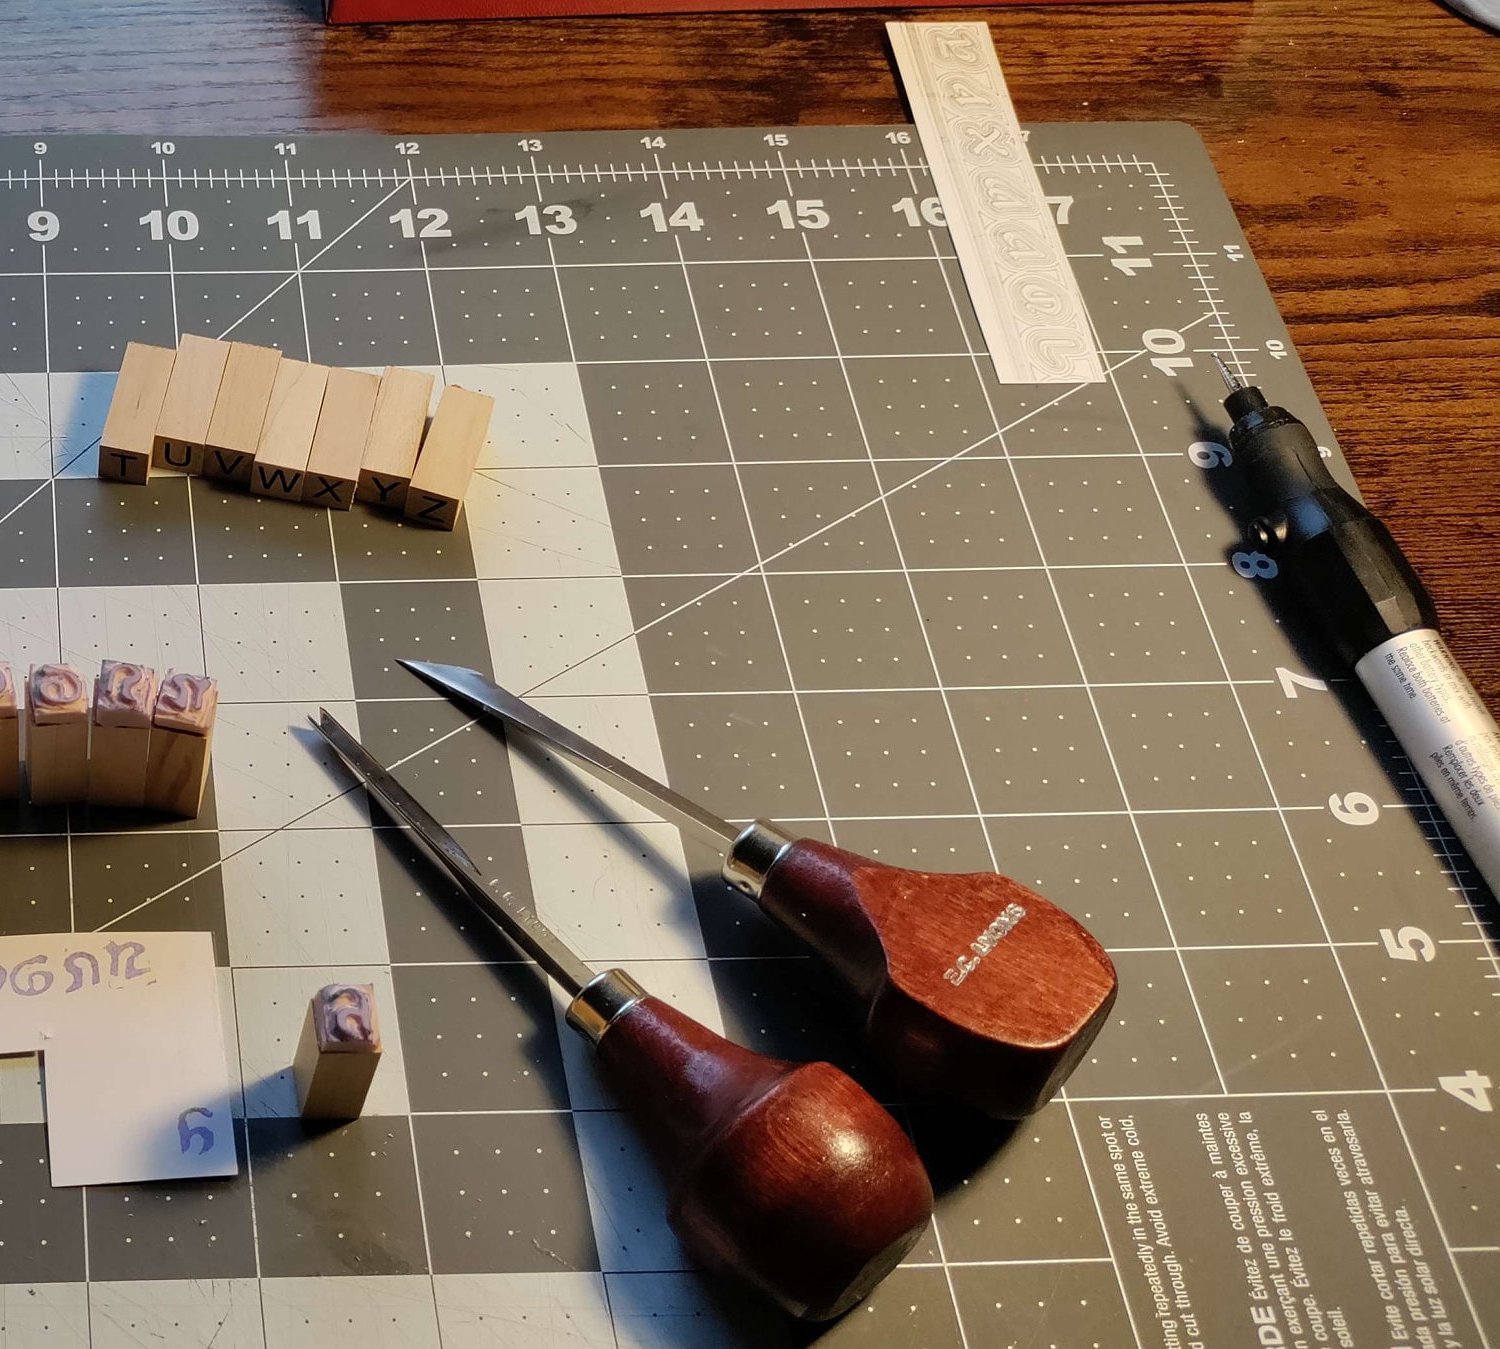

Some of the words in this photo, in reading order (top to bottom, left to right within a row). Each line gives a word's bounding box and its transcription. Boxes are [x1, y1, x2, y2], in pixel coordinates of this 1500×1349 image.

[34, 143, 48, 155] 9
[150, 142, 176, 155] 10
[273, 143, 298, 156] 11
[395, 142, 421, 155] 12
[517, 139, 544, 152] 13
[640, 137, 667, 150] 14
[762, 134, 789, 147] 15
[885, 131, 911, 145] 16
[27, 212, 60, 242] 9
[138, 210, 200, 242] 10
[266, 210, 322, 241] 11
[388, 208, 453, 239] 12
[514, 205, 578, 236] 13
[639, 202, 705, 233] 14
[766, 200, 830, 230] 15
[891, 198, 948, 228] 16
[1102, 235, 1153, 276] 11
[1224, 244, 1245, 262] 11
[1142, 329, 1194, 377] 10
[1265, 339, 1288, 360] 10
[111, 453, 138, 477] T
[164, 442, 192, 467] U
[214, 450, 244, 475] V
[1187, 442, 1232, 469] 9
[258, 466, 301, 494] W
[313, 476, 344, 502] X
[371, 476, 401, 501] Y
[417, 496, 448, 523] Z
[1231, 550, 1279, 579] 8
[1275, 667, 1328, 698] 7
[1328, 792, 1380, 826] 6
[1379, 926, 1436, 962] 5
[1438, 1069, 1493, 1112] 4
[1098, 1115, 1113, 1129] or
[1118, 1114, 1140, 1146] cold,
[1239, 1111, 1253, 1124] la
[1311, 1109, 1328, 1121] el
[1101, 1131, 1123, 1161] spot
[1196, 1112, 1223, 1165] maintes
[1217, 1112, 1248, 1176] excessive
[1320, 1126, 1336, 1143] en
[1336, 1109, 1374, 1186] atravesarla.
[1246, 1129, 1274, 1186] extrême,
[1328, 1147, 1351, 1186] veces
[1113, 1163, 1134, 1200] same
[1131, 1150, 1158, 1205] extreme
[1212, 1169, 1228, 1179] à
[1126, 1202, 1142, 1225] the
[1218, 1183, 1244, 1231] couper
[1240, 1180, 1273, 1237] pression
[1263, 1192, 1287, 1223] froid
[1344, 1190, 1377, 1254] repetidas
[1365, 1189, 1390, 1228] evitar
[1132, 1228, 1147, 1240] in
[1147, 1208, 1172, 1247] Avoid
[1278, 1228, 1293, 1241] le
[1395, 1205, 1423, 1257] directa.
[1236, 1235, 1252, 1253] de
[1262, 1242, 1280, 1269] une
[1381, 1232, 1406, 1264] para
[1136, 1243, 1171, 1318] repeatedly
[1162, 1251, 1191, 1309] through.
[1368, 1258, 1394, 1300] cortar
[1413, 1259, 1438, 1295] solar
[1269, 1273, 1303, 1335] exerçant
[1394, 1268, 1429, 1322] presión
[1428, 1297, 1447, 1319] luz
[1180, 1313, 1199, 1337] cut
[1303, 1294, 1328, 1341] coupe.
[1327, 1306, 1354, 1348] soleil.
[1385, 1305, 1409, 1340] Evite
[1437, 1322, 1454, 1336] la
